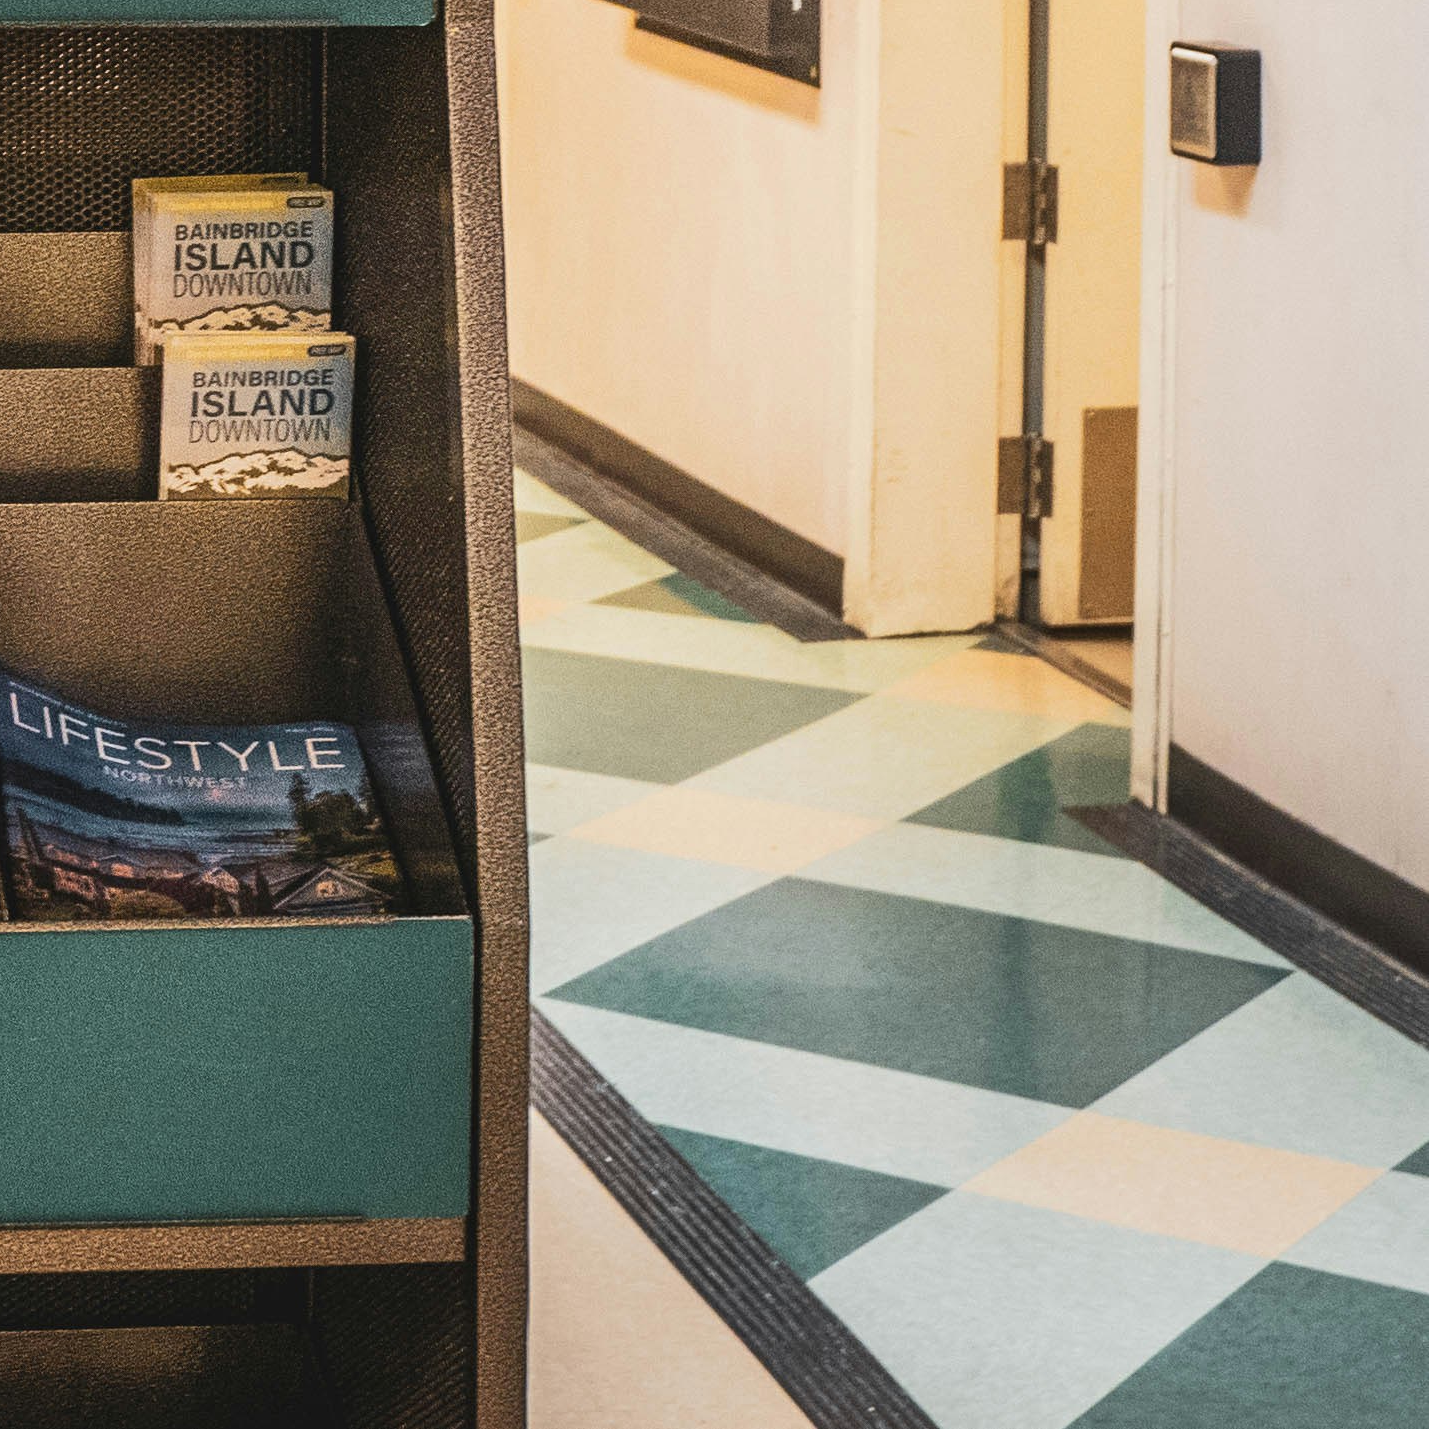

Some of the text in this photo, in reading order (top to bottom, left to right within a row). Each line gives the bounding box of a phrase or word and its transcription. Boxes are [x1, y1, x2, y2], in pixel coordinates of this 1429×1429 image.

[175, 221, 313, 241] BAINBRIDGE
[174, 241, 315, 271] ISLAND
[173, 271, 312, 298] DOWNTOWN
[9, 691, 346, 772] LIFESTYLE
[102, 765, 245, 789] NORTHWEST
